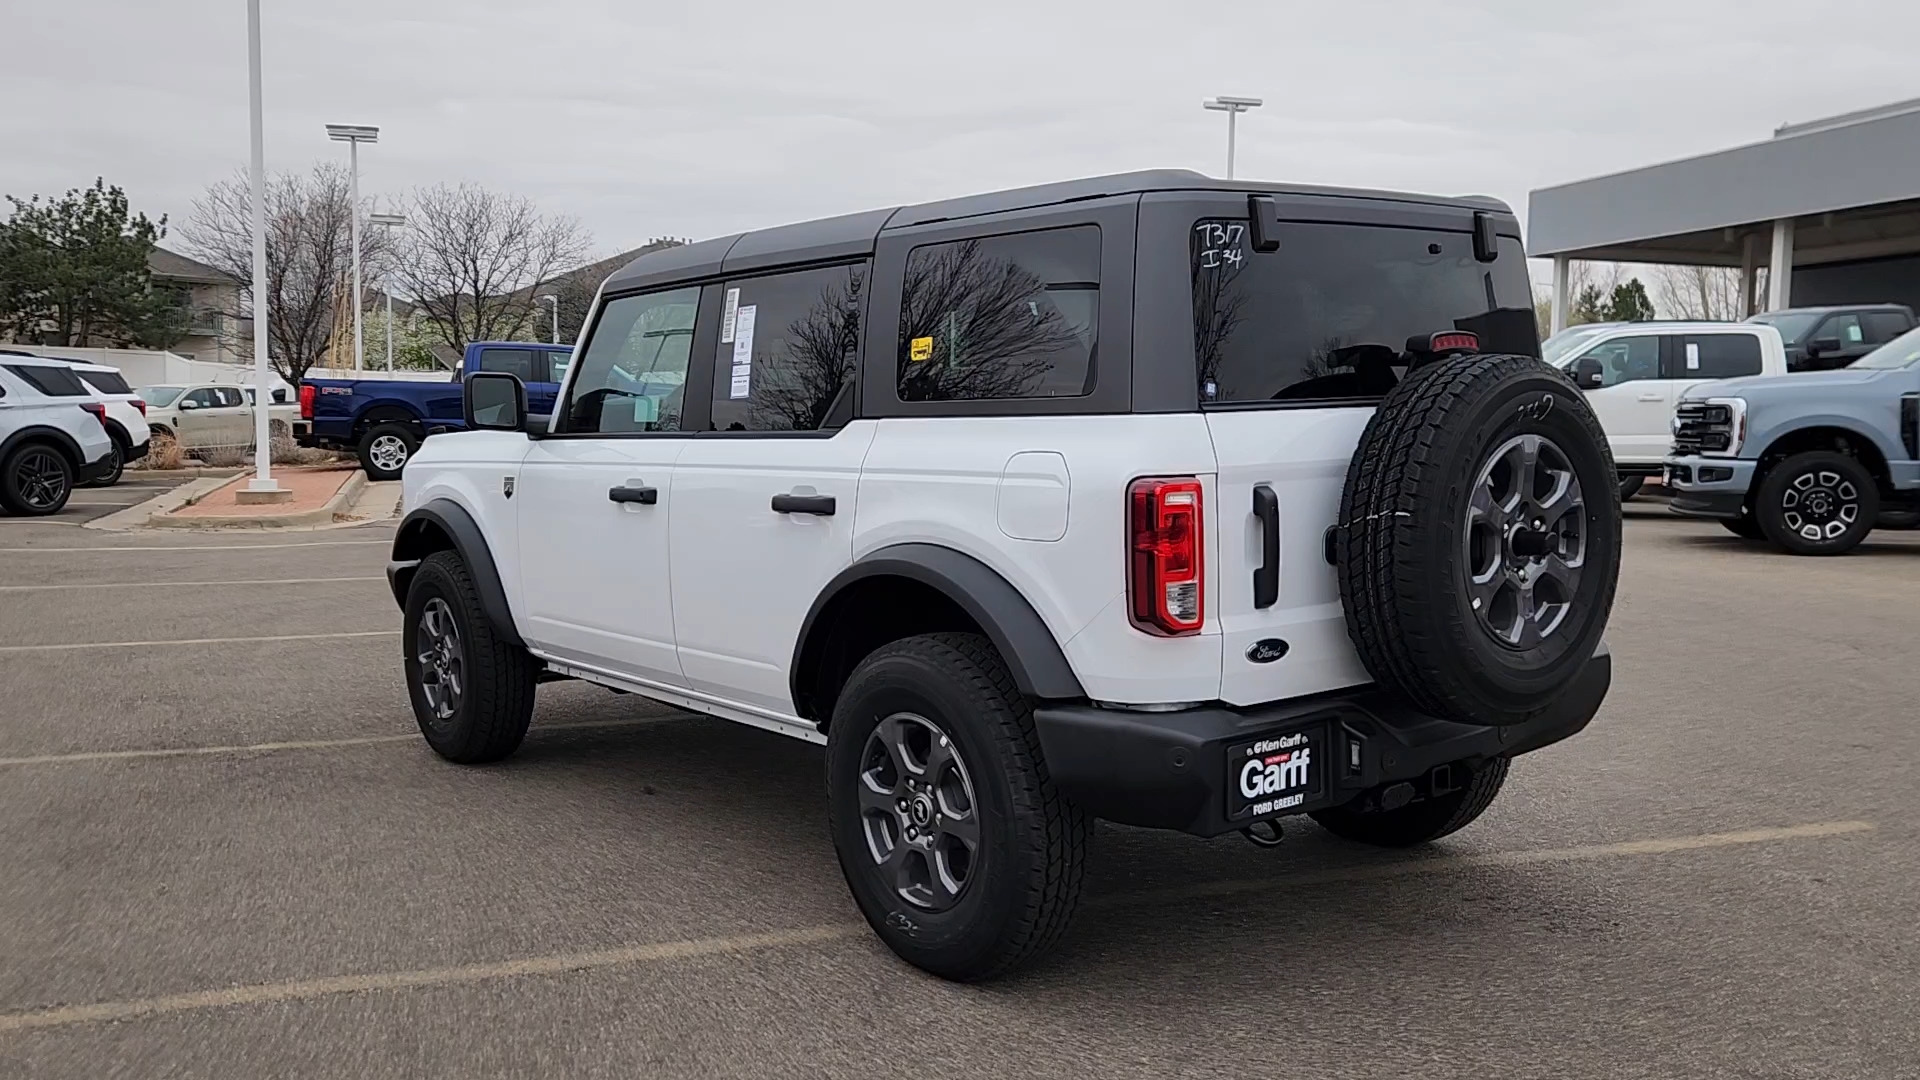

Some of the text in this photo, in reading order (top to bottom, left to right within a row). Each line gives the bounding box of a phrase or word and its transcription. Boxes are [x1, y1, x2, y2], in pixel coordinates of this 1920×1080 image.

[1257, 645, 1281, 660] Ford
[1240, 747, 1311, 799] Garff
[1253, 793, 1304, 816] FORD GREELEY
